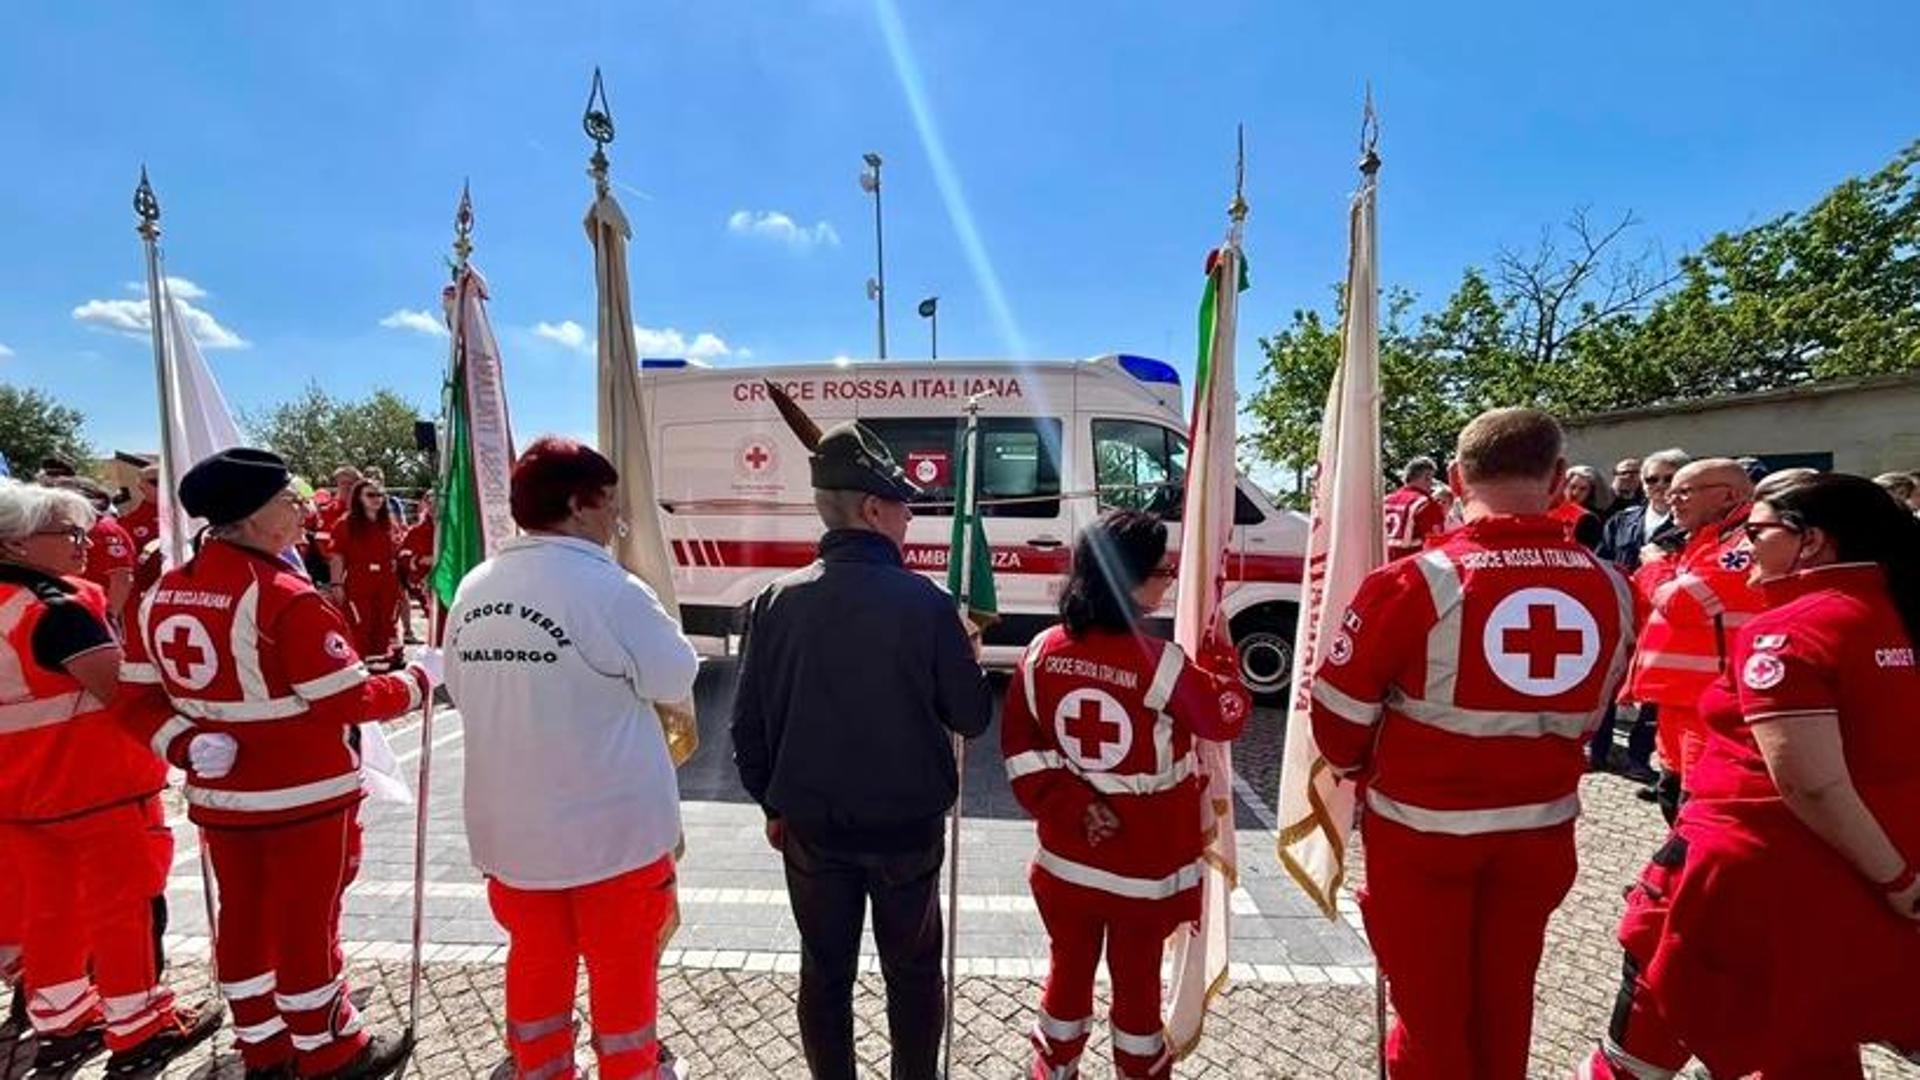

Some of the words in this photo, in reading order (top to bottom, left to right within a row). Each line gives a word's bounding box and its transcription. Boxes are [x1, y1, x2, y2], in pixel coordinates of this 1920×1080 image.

[823, 379, 905, 400] ROSSA
[911, 378, 1022, 399] ITALIANA
[904, 550, 1022, 568] AMBZA
[1502, 548, 1545, 567] ROSSA
[464, 602, 515, 624] CROCE
[520, 605, 572, 649] VERDE
[1045, 655, 1073, 676] CROCE
